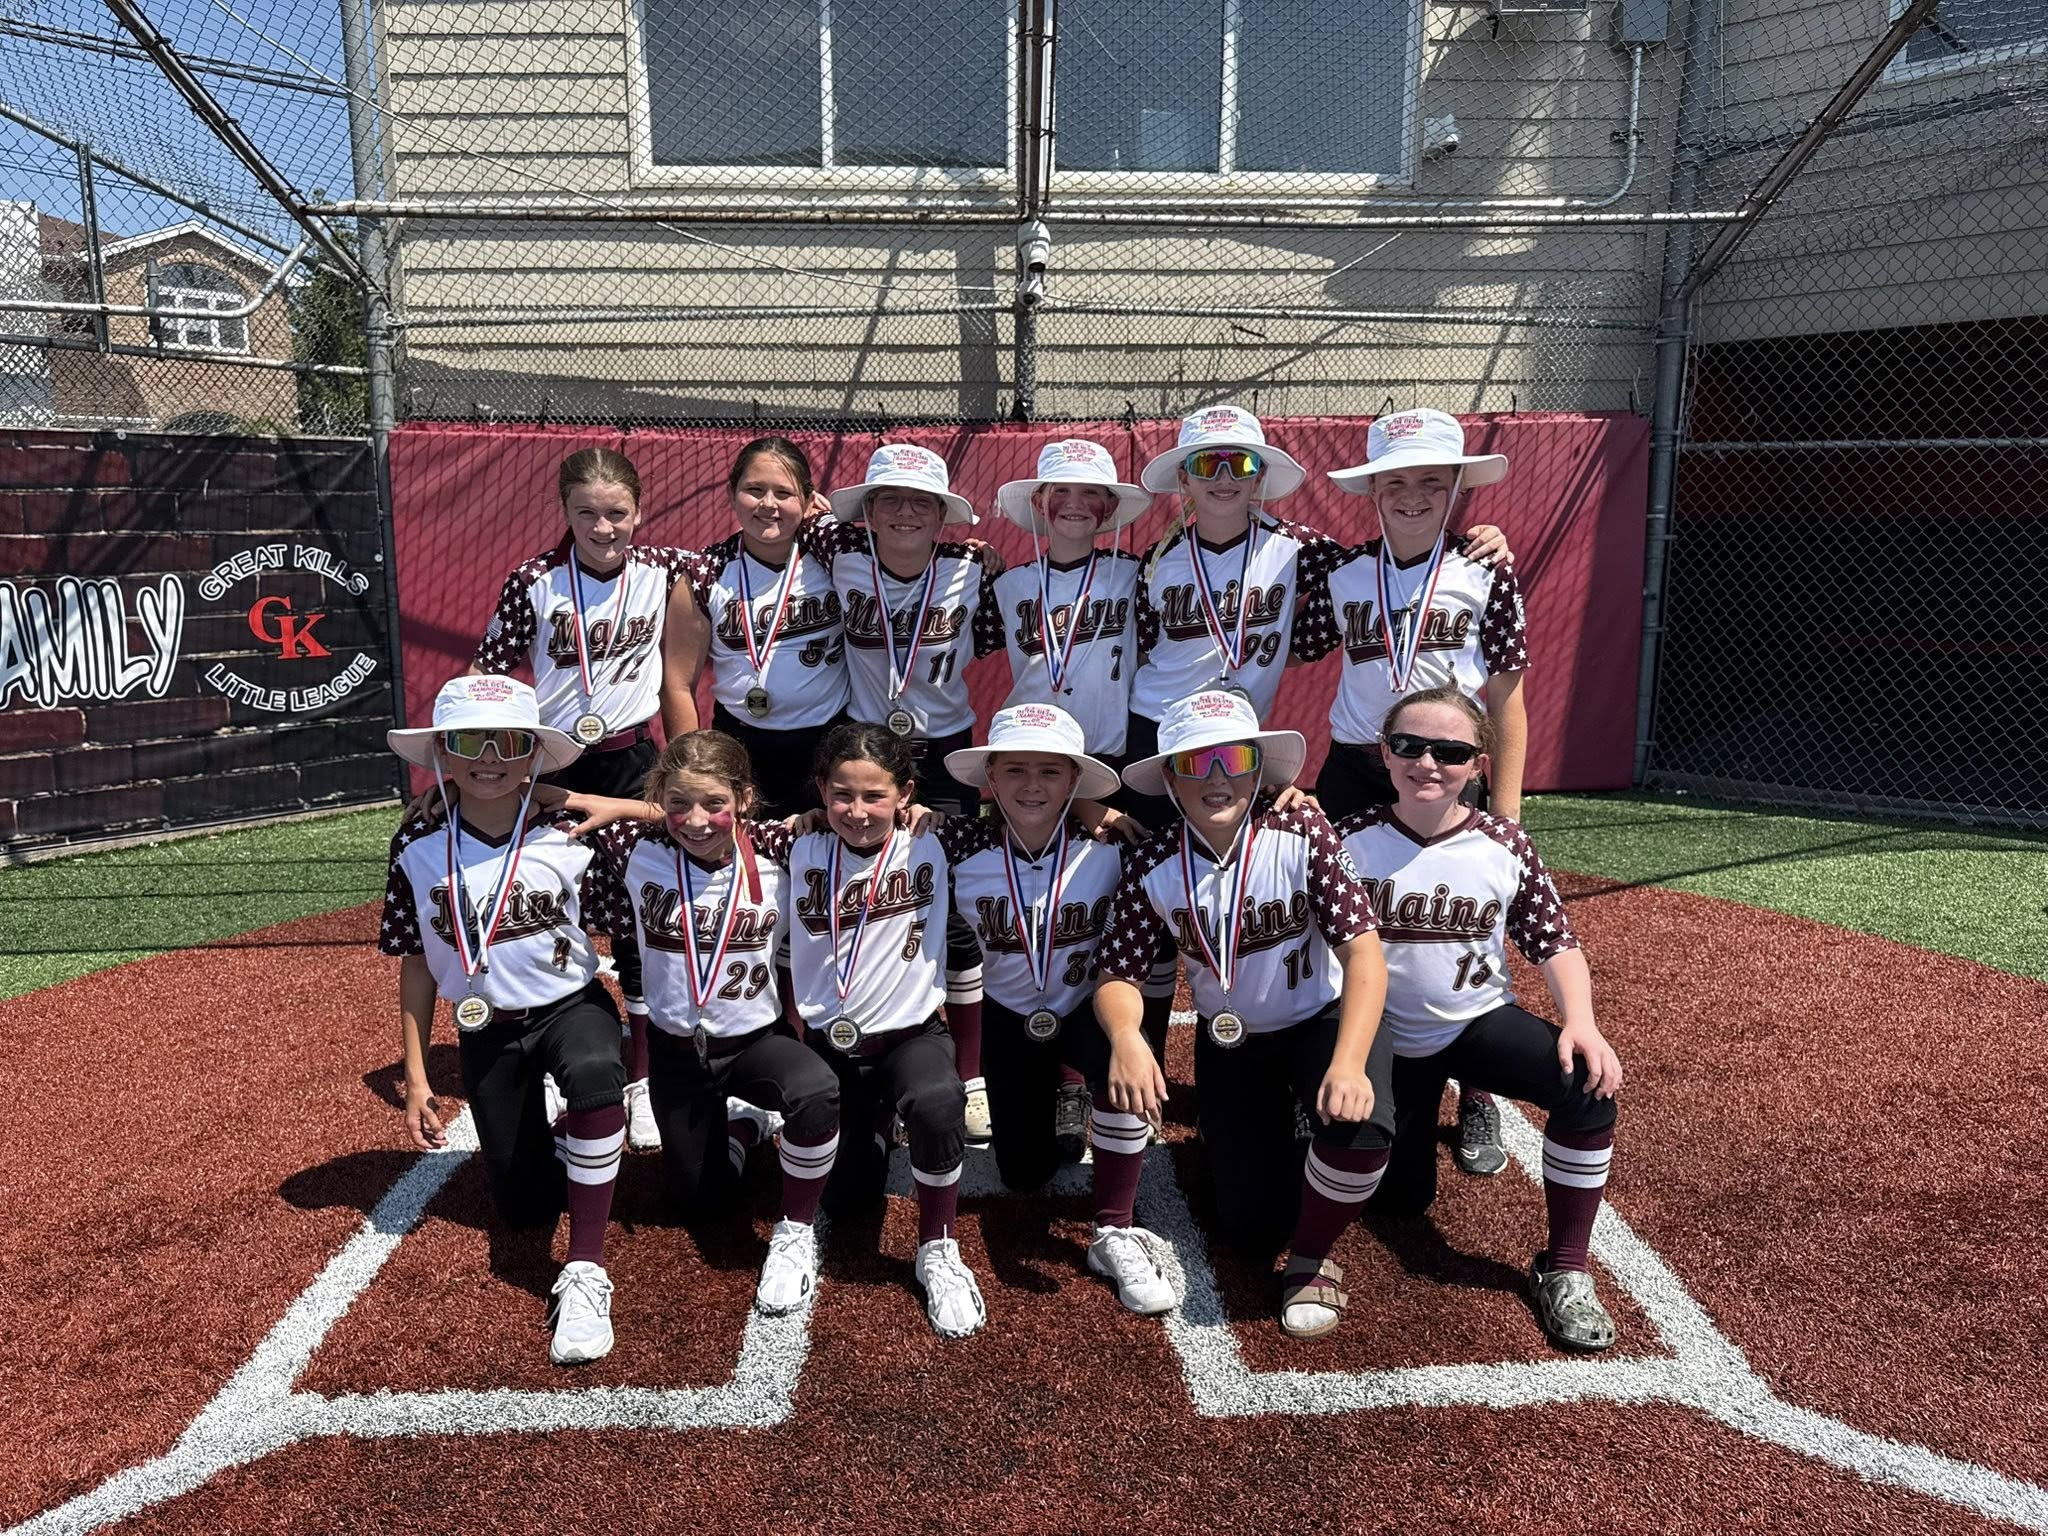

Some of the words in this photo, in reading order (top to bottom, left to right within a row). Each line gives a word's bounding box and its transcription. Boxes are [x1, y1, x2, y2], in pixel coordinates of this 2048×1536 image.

[200, 544, 288, 601] GREAT
[293, 545, 370, 597] KILLS
[205, 662, 288, 712] LITTLE
[290, 653, 377, 712] LEAGUE
[928, 649, 957, 684] 11
[1110, 645, 1123, 681] 7
[1358, 878, 1502, 932] Maine
[901, 918, 927, 962] 5
[717, 961, 770, 1000] 29
